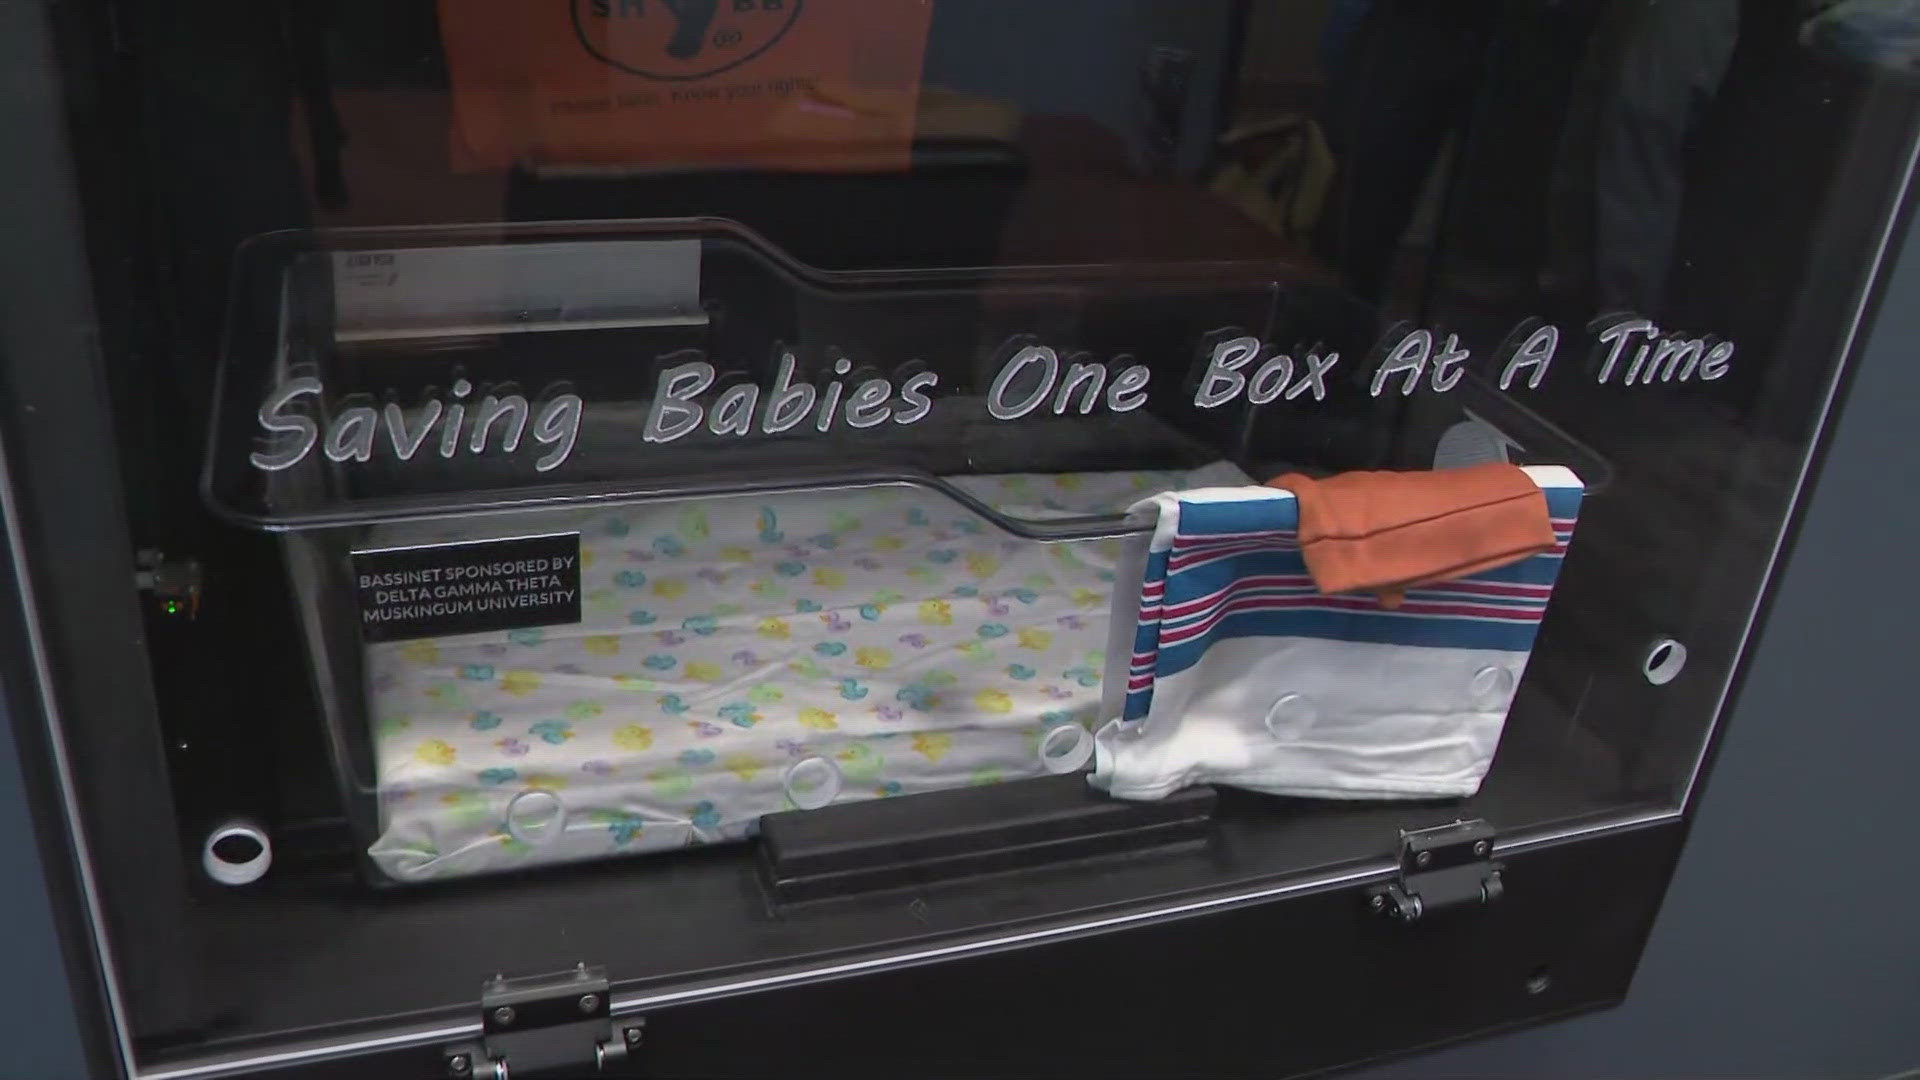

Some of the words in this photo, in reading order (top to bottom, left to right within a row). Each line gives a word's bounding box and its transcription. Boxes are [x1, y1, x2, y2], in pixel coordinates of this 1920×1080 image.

[250, 377, 583, 472] Saving
[643, 353, 938, 444] Babies
[986, 345, 1150, 421] One
[1194, 336, 1340, 408] Box
[1370, 328, 1469, 397] At
[1499, 325, 1559, 392] A
[1597, 320, 1734, 387] Time
[360, 568, 442, 589] BASSINET
[446, 558, 548, 581] SPONSORED
[552, 556, 575, 571] BY
[363, 601, 473, 622] MUSKINGUM
[476, 589, 575, 612] UNIVERSITY
[375, 587, 432, 605] DELTA
[434, 581, 504, 599] GAMMA
[506, 574, 562, 592] THETA
